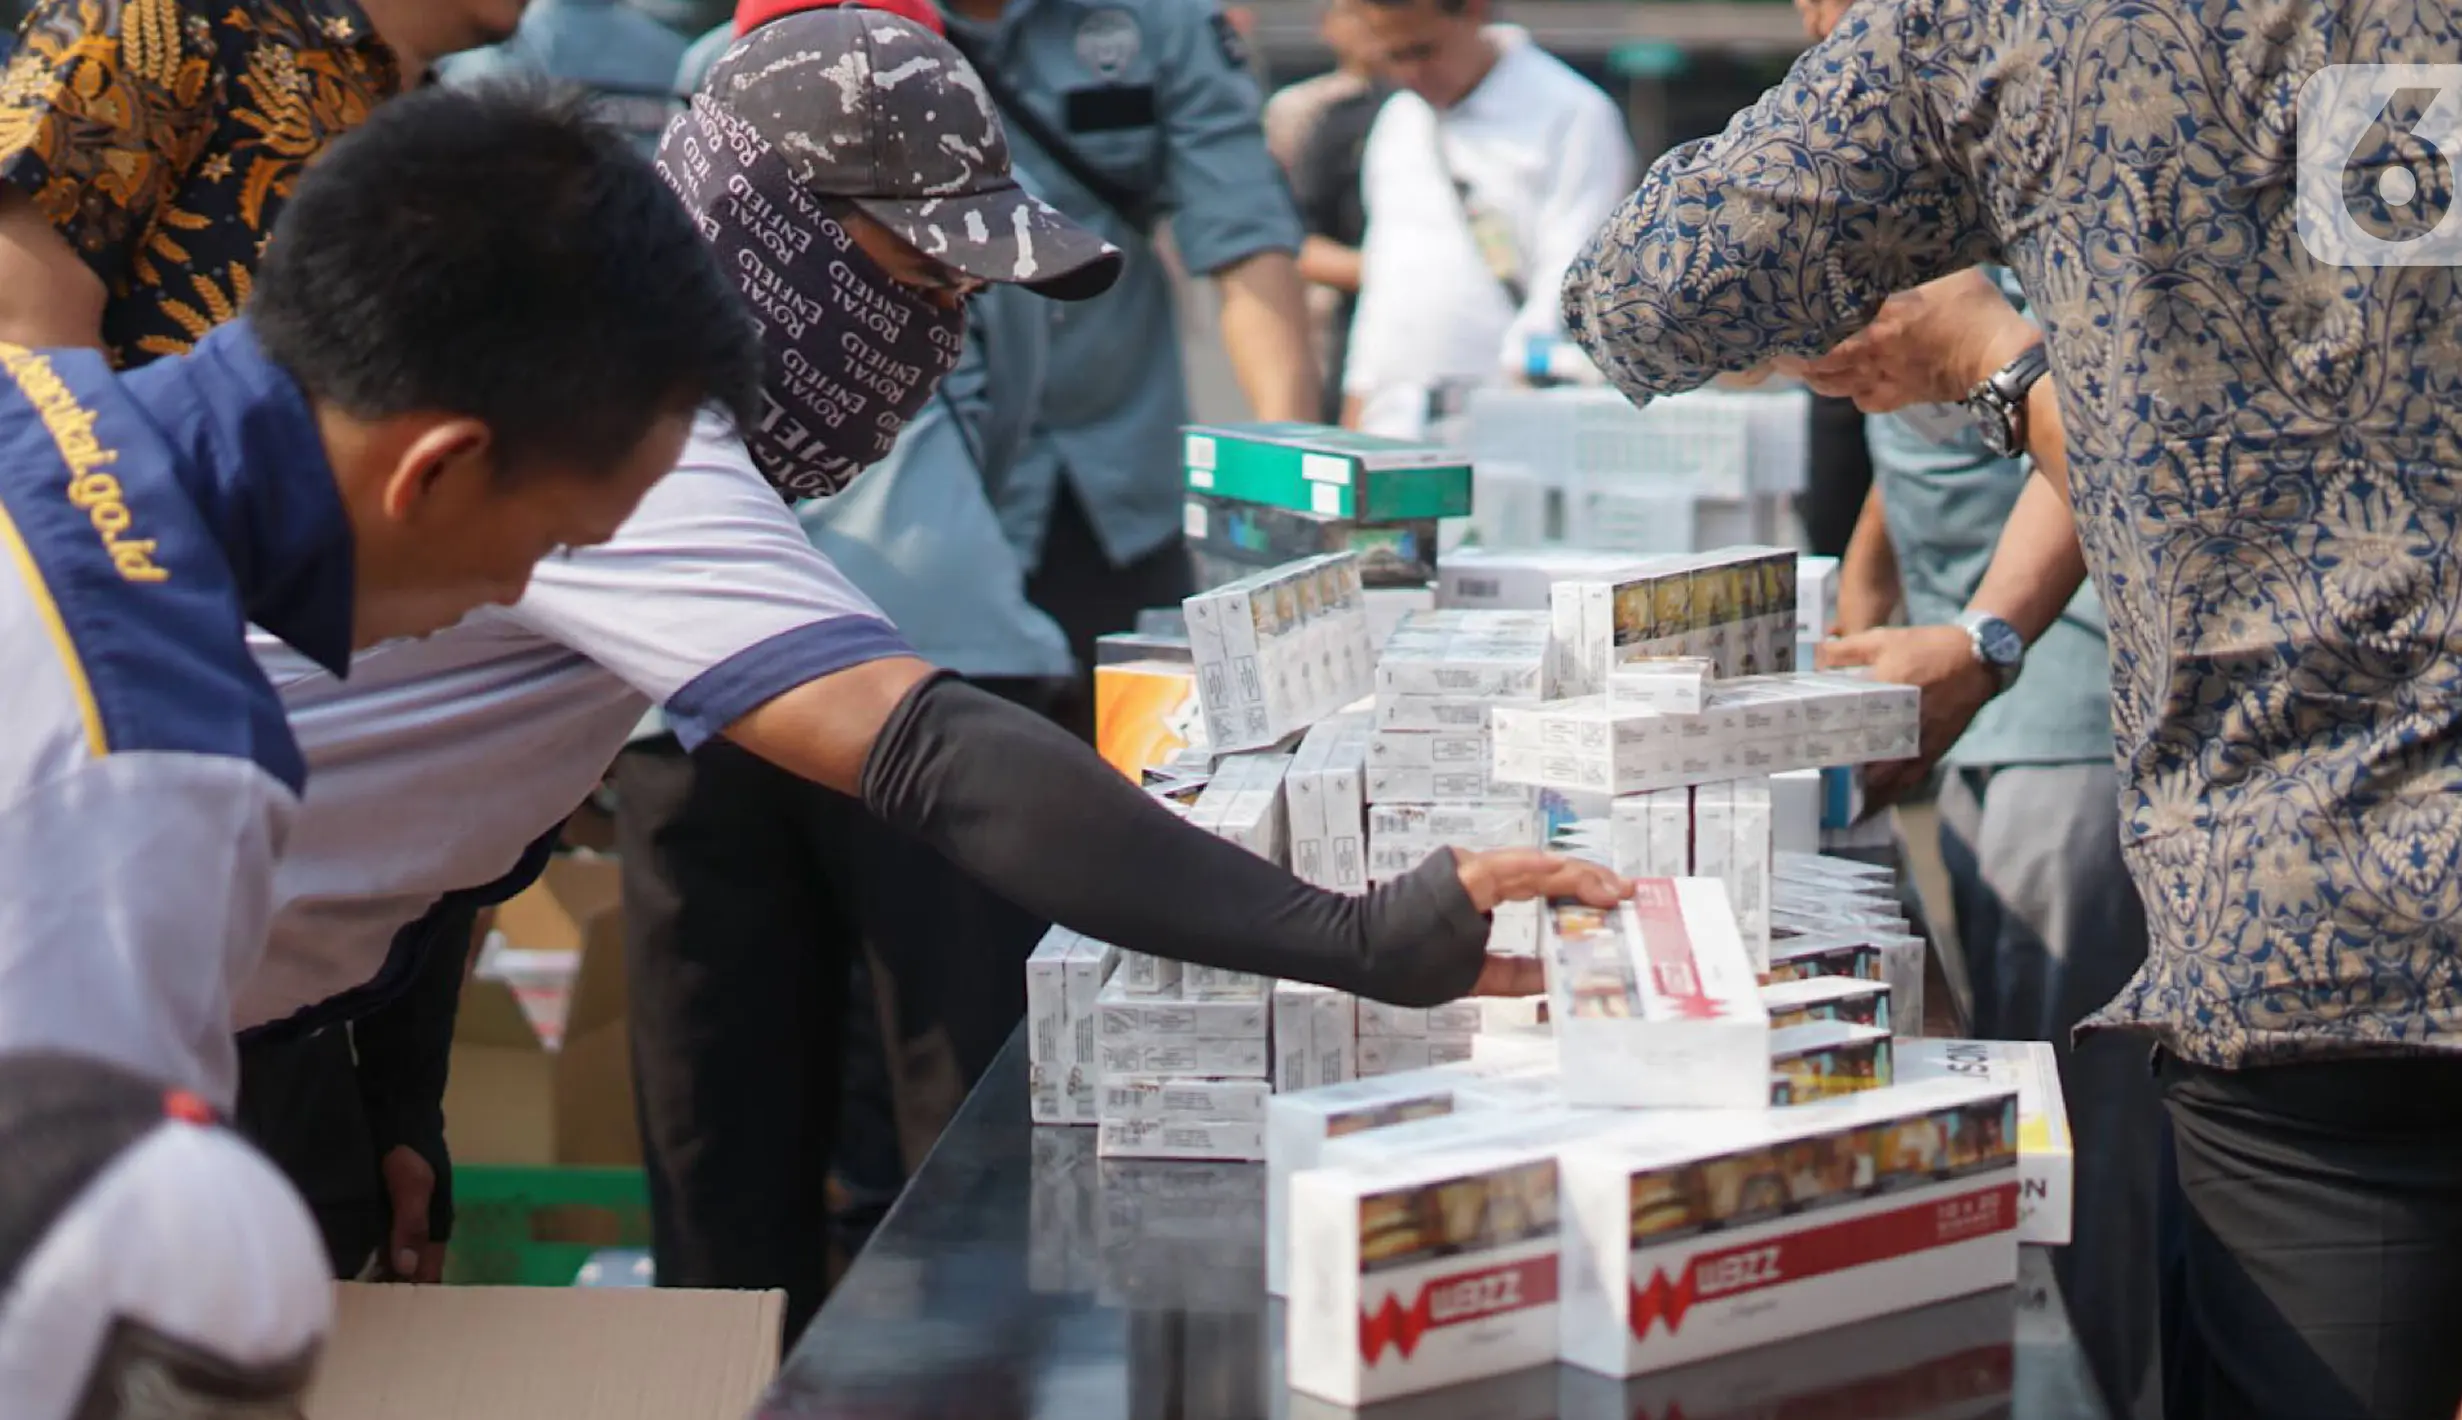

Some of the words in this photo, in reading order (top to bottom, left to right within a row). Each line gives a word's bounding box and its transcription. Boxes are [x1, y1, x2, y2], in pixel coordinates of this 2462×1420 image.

[729, 173, 812, 253] ENFIELD
[729, 197, 794, 265] ROYAL
[788, 185, 853, 253] ROYAL
[738, 249, 823, 325] ENFIELD
[740, 273, 806, 340] ROYAL
[829, 260, 912, 326] ENFIELD
[831, 284, 901, 344] ROYAL
[782, 349, 867, 415] ENFIELD
[841, 331, 922, 387] ENFIELD
[843, 355, 906, 405] ROYAL
[781, 369, 848, 429] ROYAL
